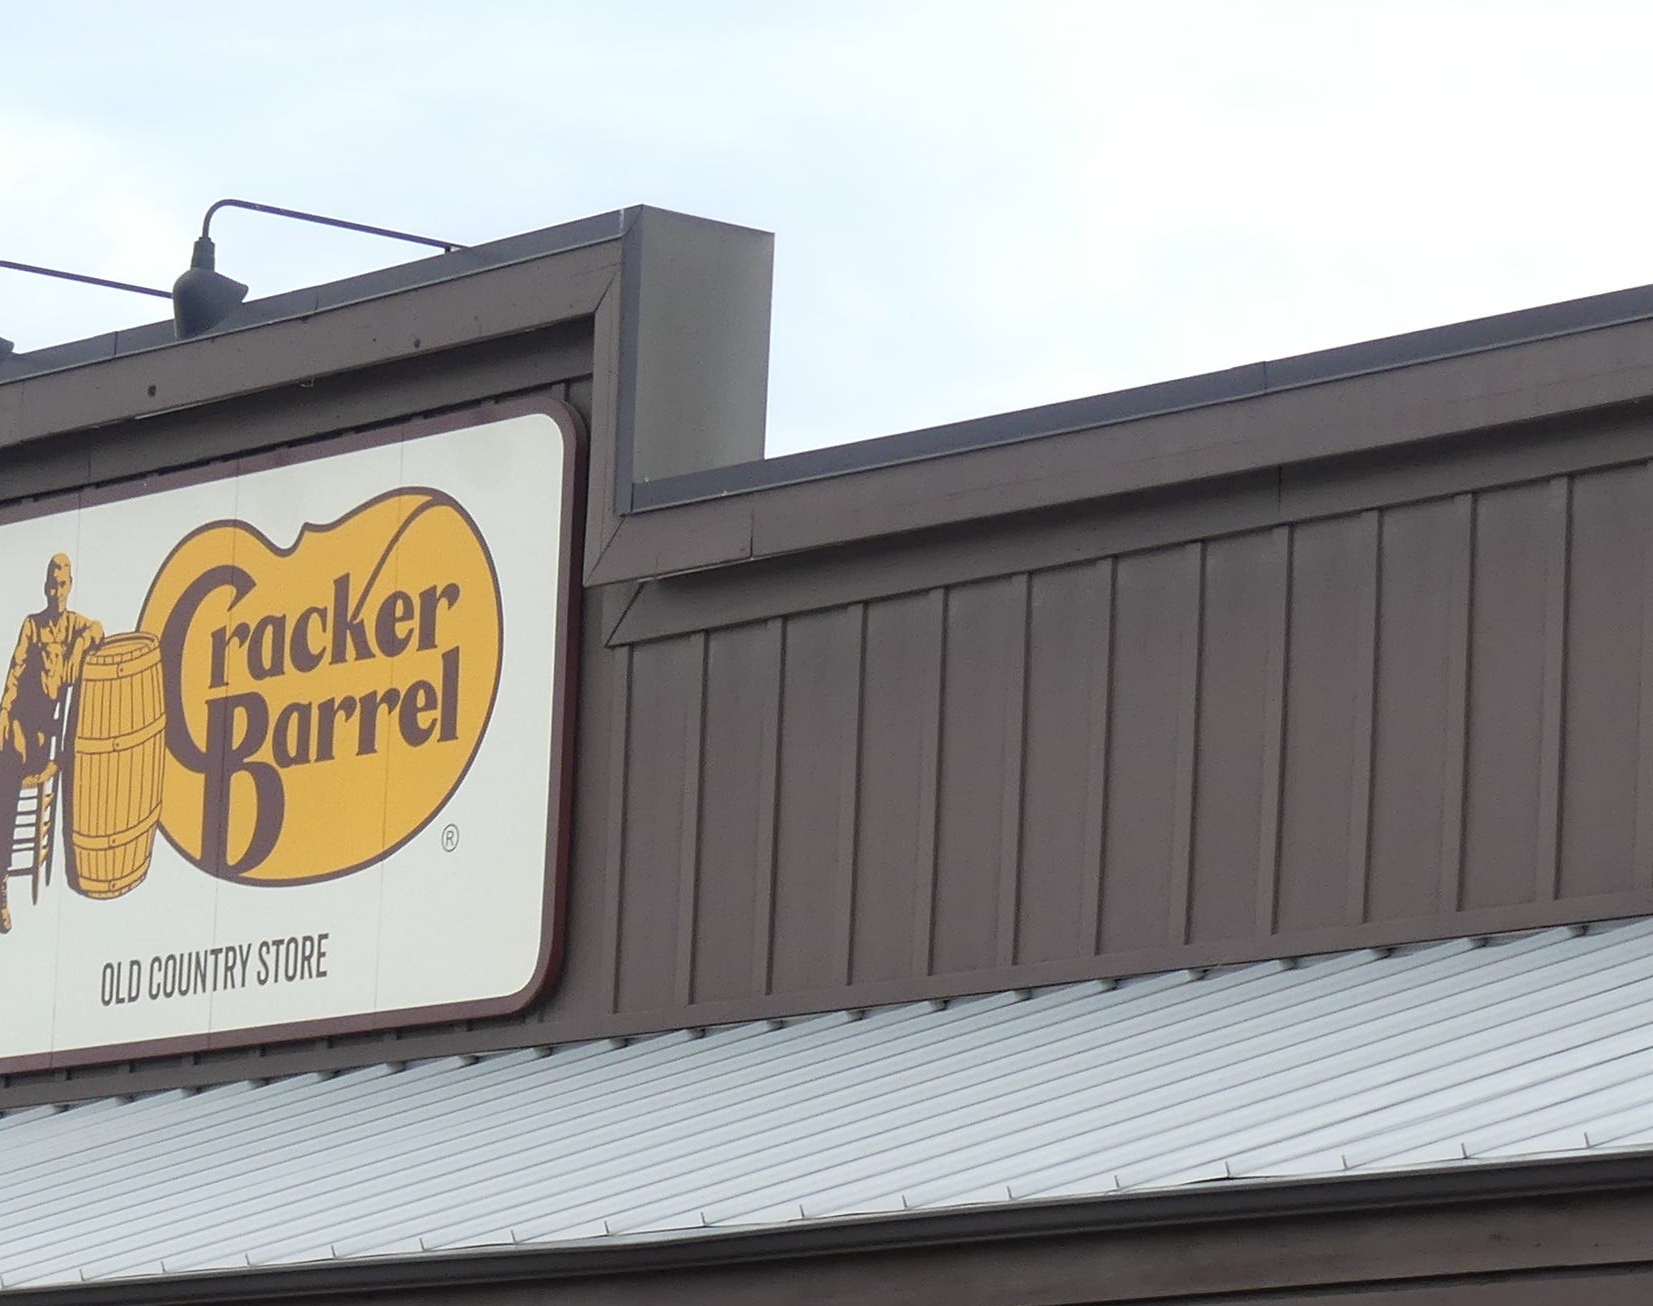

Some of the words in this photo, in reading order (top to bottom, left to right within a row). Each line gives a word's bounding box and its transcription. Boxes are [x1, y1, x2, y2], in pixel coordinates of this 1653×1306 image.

[160, 564, 461, 774] Cracker
[200, 645, 461, 877] Barrel
[101, 960, 142, 1007] OLD
[148, 943, 252, 1000] COUNTRY
[256, 933, 330, 986] STORE
